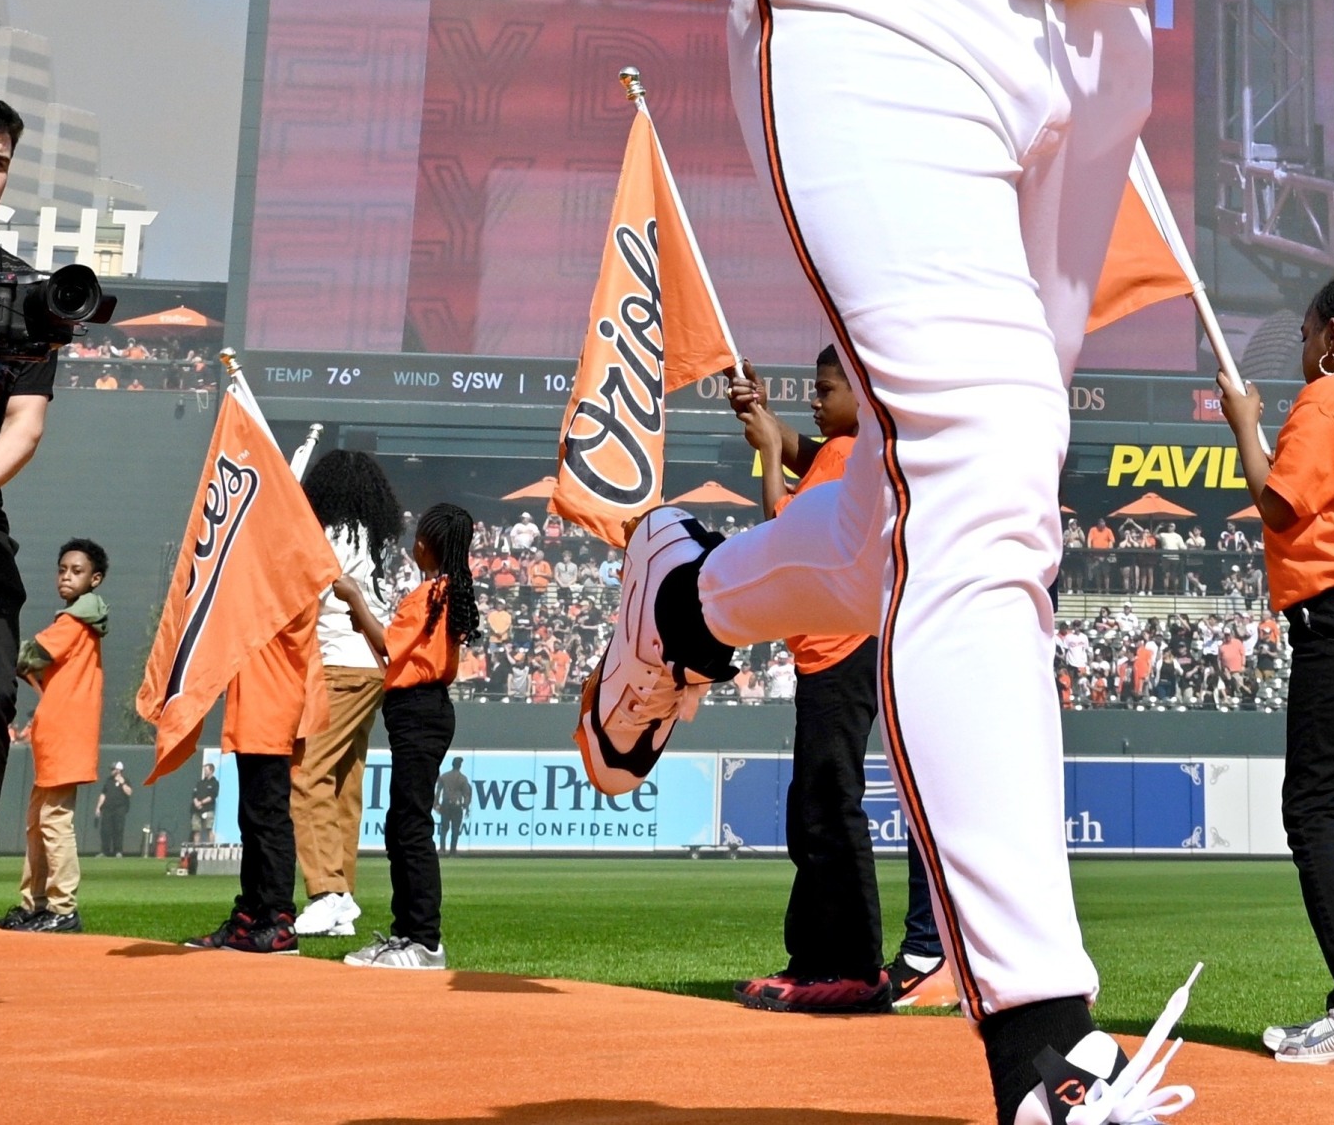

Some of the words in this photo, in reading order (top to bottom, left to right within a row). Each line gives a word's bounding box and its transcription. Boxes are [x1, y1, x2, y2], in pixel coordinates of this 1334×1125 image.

[265, 367, 312, 383] TEMP
[327, 367, 360, 385] 76°
[394, 371, 439, 386] WIND
[452, 371, 503, 392] S/SW
[1107, 445, 1249, 489] PAVIL
[518, 823, 657, 837] CONFIDENCE
